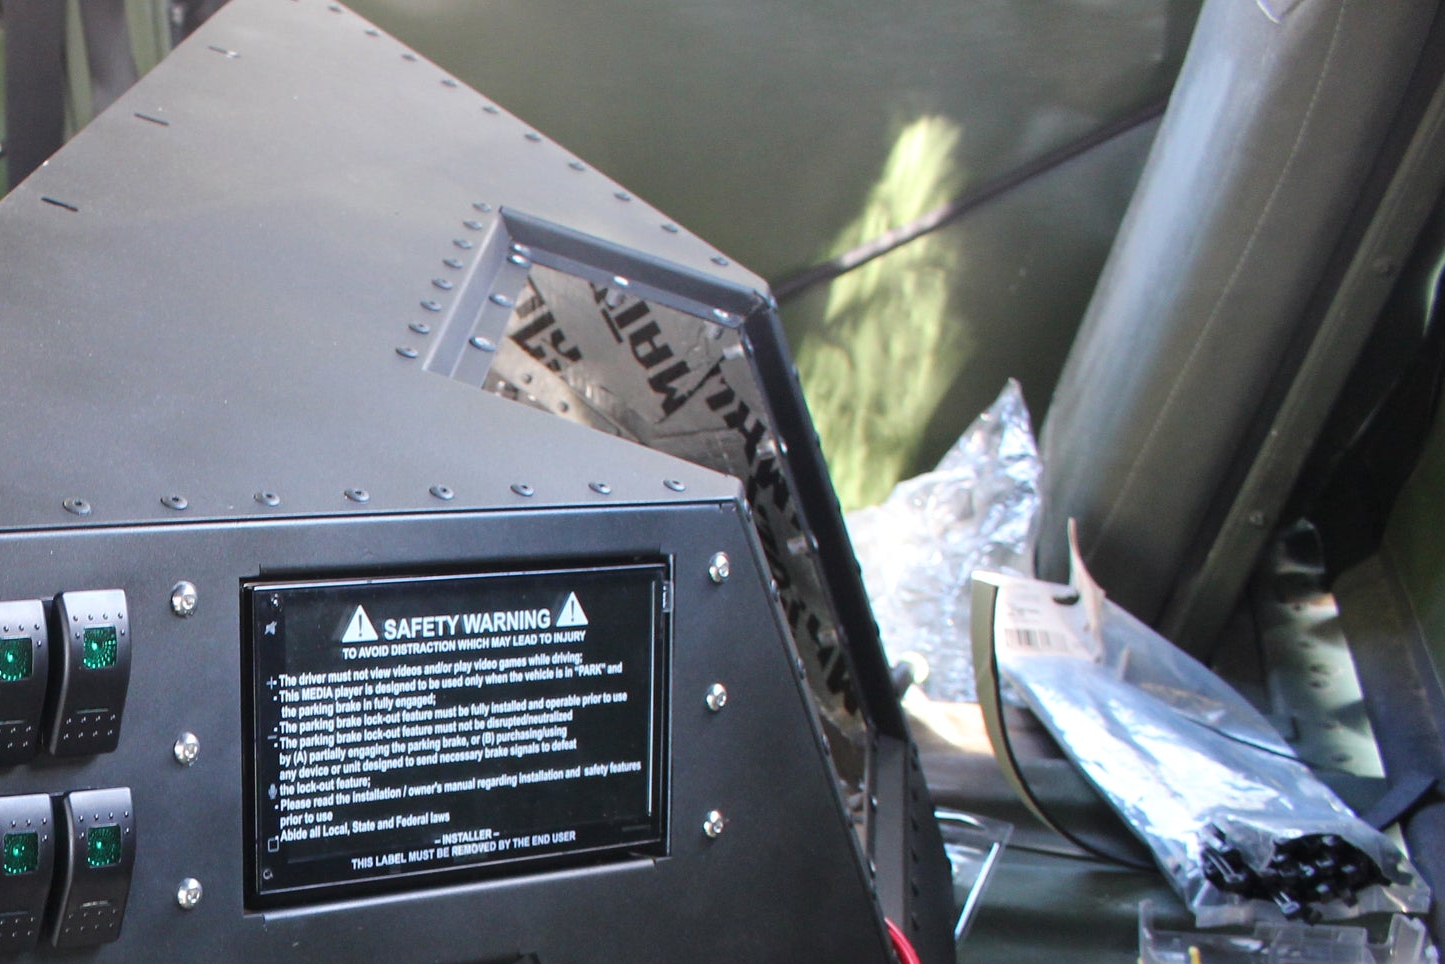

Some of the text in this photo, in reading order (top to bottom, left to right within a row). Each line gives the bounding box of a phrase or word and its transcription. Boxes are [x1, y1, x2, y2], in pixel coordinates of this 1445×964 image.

[384, 610, 551, 640] SAFETY WARNING
[342, 631, 586, 659] TO AVOID DISTRACTION WHICH MAY LEAD TO INJURY
[279, 652, 583, 687] The driver must not view videos and/or play video games while driving;
[279, 689, 300, 703] This
[301, 686, 334, 701] MEDIA
[334, 683, 364, 701] player
[364, 683, 374, 696] is
[374, 679, 417, 696] designed
[416, 678, 428, 691] to
[428, 677, 440, 690] be
[441, 675, 464, 689] used
[464, 674, 484, 689] only
[484, 672, 508, 685] when
[508, 670, 524, 683] the
[524, 668, 554, 682] vehicle
[555, 667, 564, 679] is
[564, 666, 573, 679] in
[606, 662, 623, 675] and
[279, 693, 628, 734] The parking brake lock-out feature must be fully installed and operable prior to use
[281, 704, 297, 717] the
[298, 701, 334, 719] parking
[335, 699, 362, 713] brake
[373, 697, 394, 712] fully
[394, 694, 436, 711] engaged;
[279, 710, 573, 750] The parking brake lock-out feature must not be disrupted/neutralized
[279, 725, 567, 766] by (A) partially engaging the parking brake, or (B) purchasing/using
[279, 738, 577, 782] any device or unit designed to send necessary brake signals to defeat
[279, 776, 371, 796] the lock-out feature;
[280, 796, 312, 810] Please
[313, 794, 334, 807] read
[335, 792, 351, 804] the
[352, 786, 402, 802] installation
[407, 782, 443, 796] owner's
[443, 779, 476, 792] manual
[476, 774, 518, 790] regarding
[518, 769, 564, 784] installation
[564, 767, 581, 779] and
[583, 764, 609, 777] safety
[609, 761, 641, 774] features
[280, 811, 333, 827] prior to use
[280, 811, 450, 842] Abide all Local, State and Federal laws
[352, 831, 576, 869] THIS LABEL MUST BE REMOVED BY THE END USER
